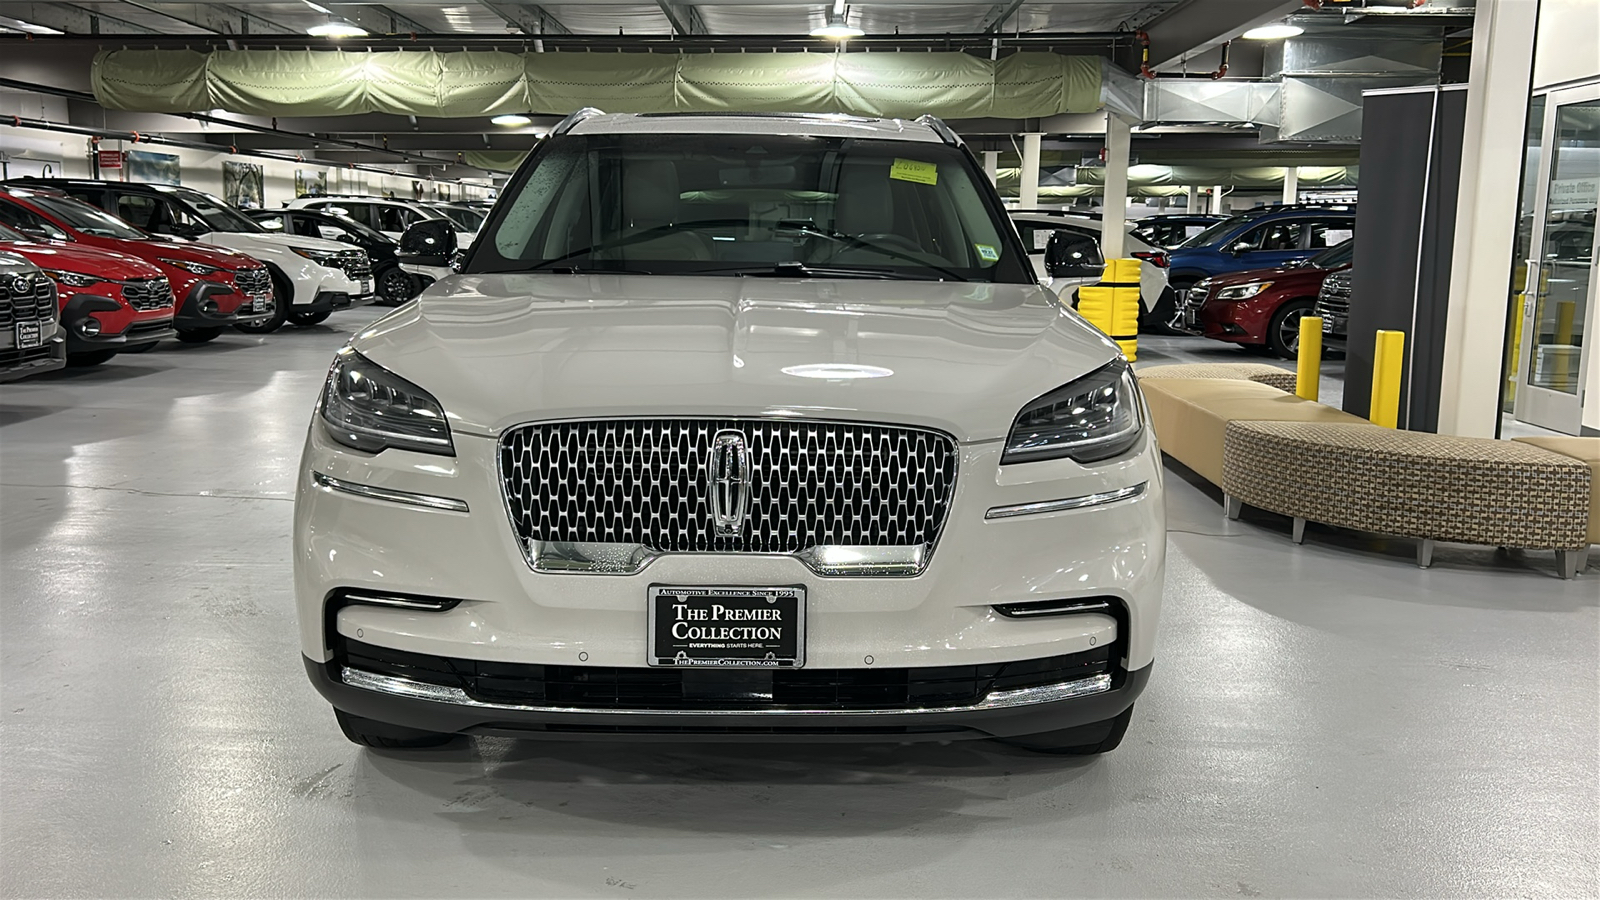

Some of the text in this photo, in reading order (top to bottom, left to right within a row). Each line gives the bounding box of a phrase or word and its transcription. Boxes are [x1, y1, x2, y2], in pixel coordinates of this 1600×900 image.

[1554, 181, 1596, 194] Private Office
[672, 604, 782, 621] THE PREMIER
[671, 621, 782, 640] COLLECTION
